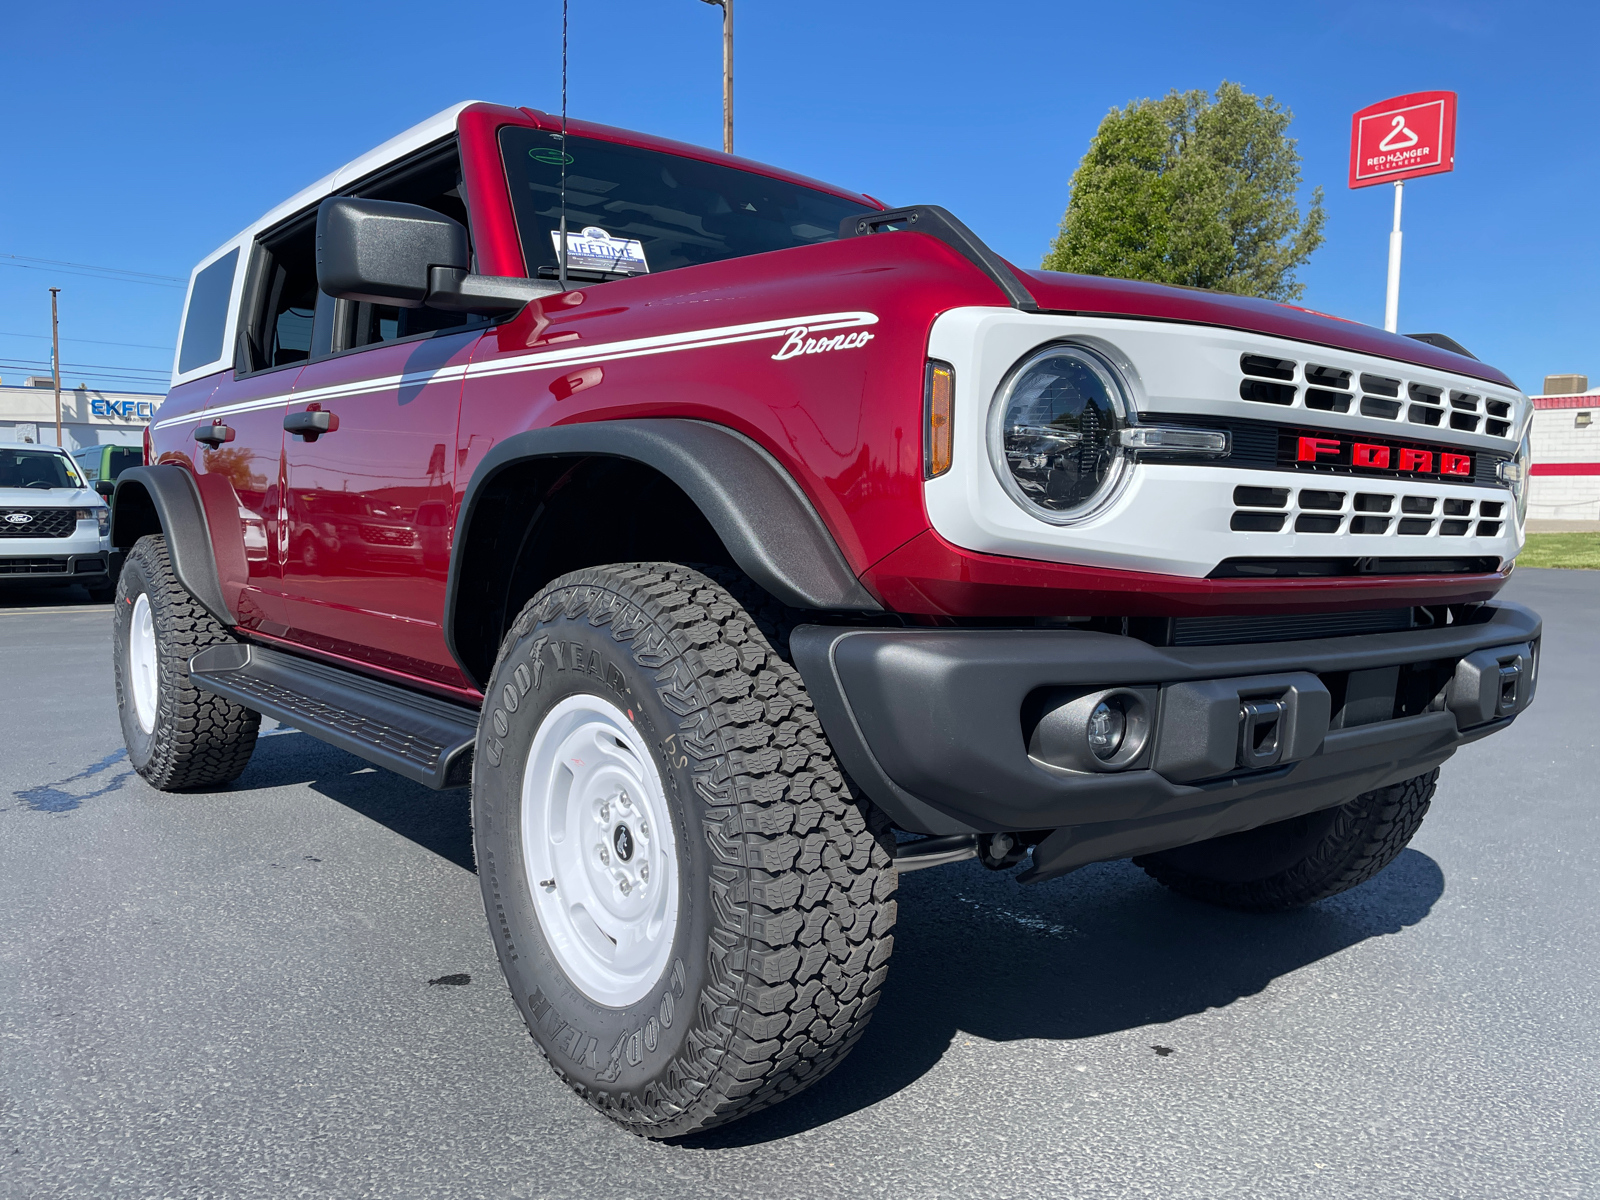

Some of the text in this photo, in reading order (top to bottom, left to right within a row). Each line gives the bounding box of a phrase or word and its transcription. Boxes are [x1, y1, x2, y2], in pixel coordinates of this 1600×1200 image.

[1367, 147, 1430, 166] RED HANGER
[1375, 157, 1421, 170] CLEANERS
[771, 326, 875, 361] Bronco
[1297, 436, 1471, 477] FORD
[8, 514, 30, 523] Ford
[485, 634, 627, 768] GOODYEAR
[527, 957, 686, 1084] GOODYEAR
